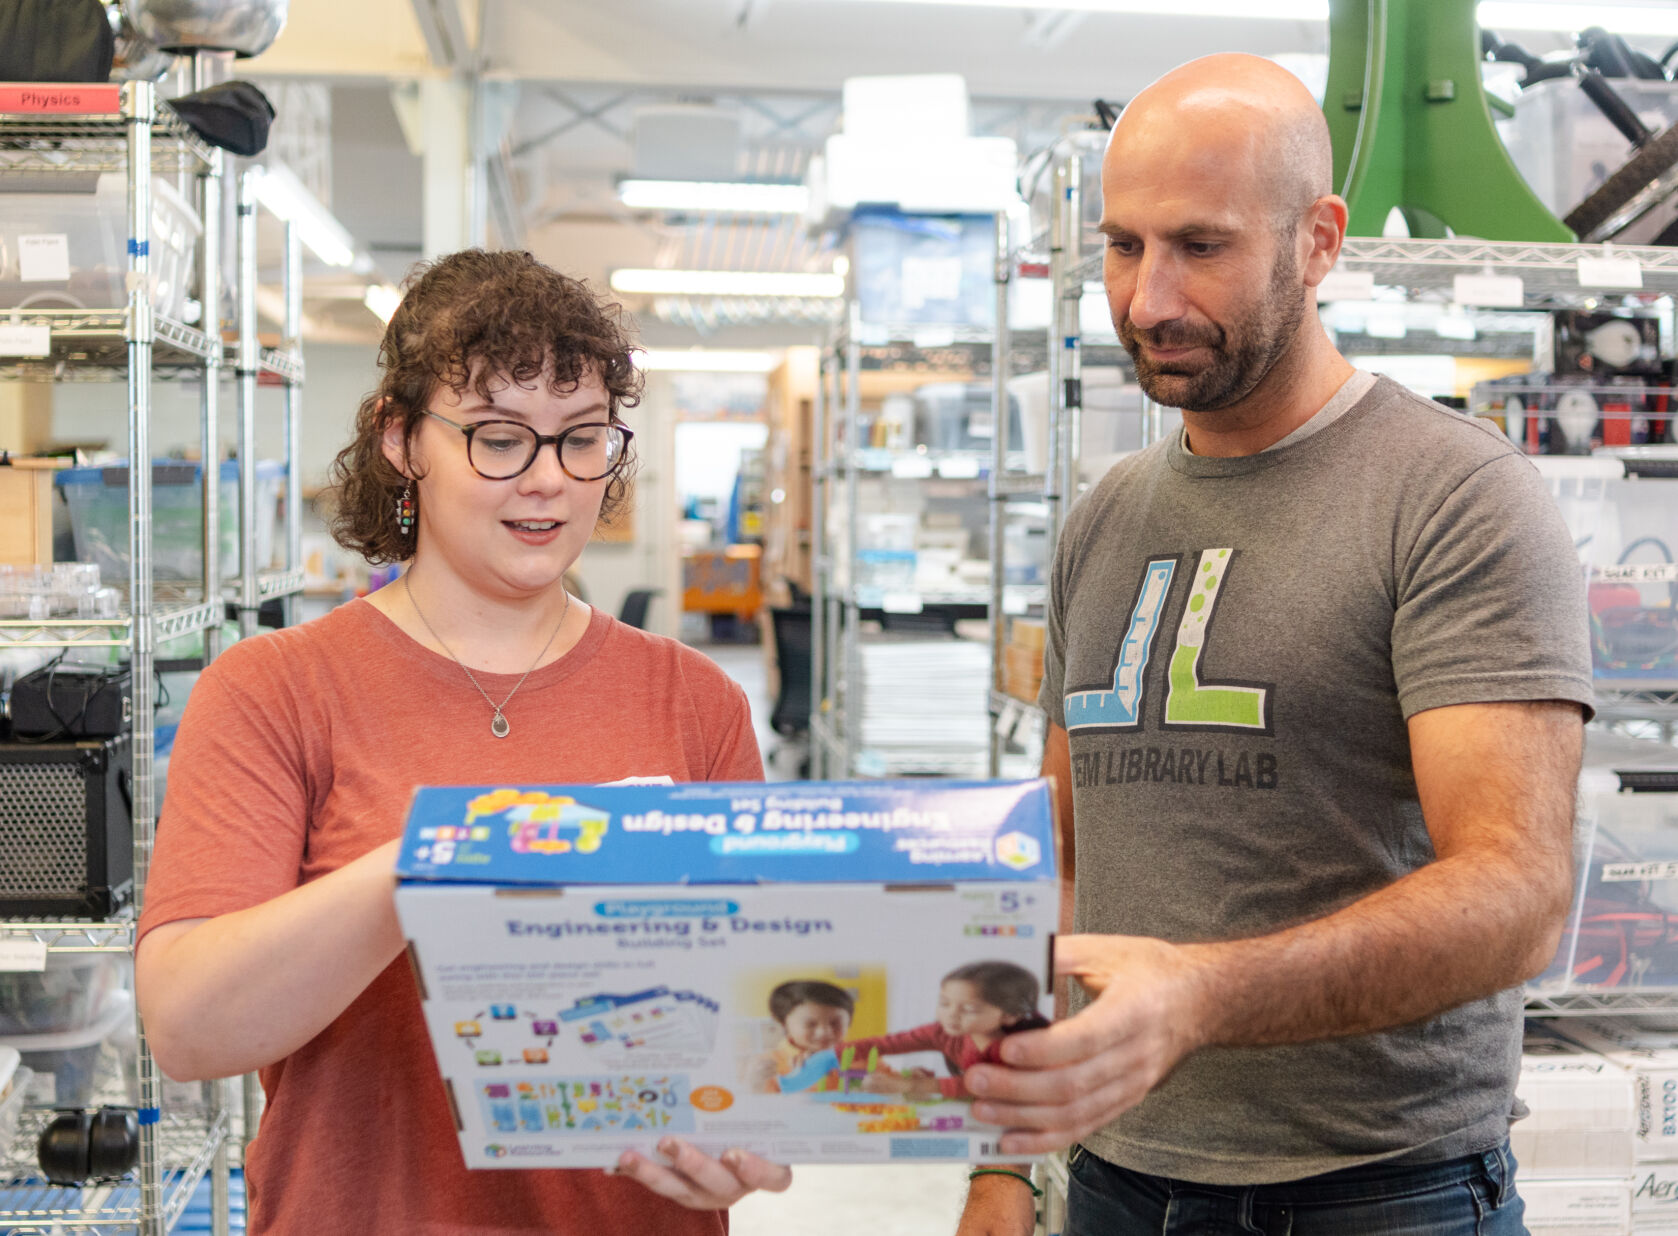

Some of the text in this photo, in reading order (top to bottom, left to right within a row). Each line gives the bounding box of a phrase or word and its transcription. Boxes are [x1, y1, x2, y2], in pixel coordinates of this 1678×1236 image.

[21, 92, 81, 108] Physics
[1072, 747, 1279, 790] EM LIBRARY LAB
[622, 808, 950, 835] Engineering & Design
[721, 834, 847, 853] Playground
[604, 901, 728, 918] Playground
[506, 917, 833, 938] Engineering & Design
[698, 936, 727, 948] Set
[1662, 1079, 1677, 1137] BX100
